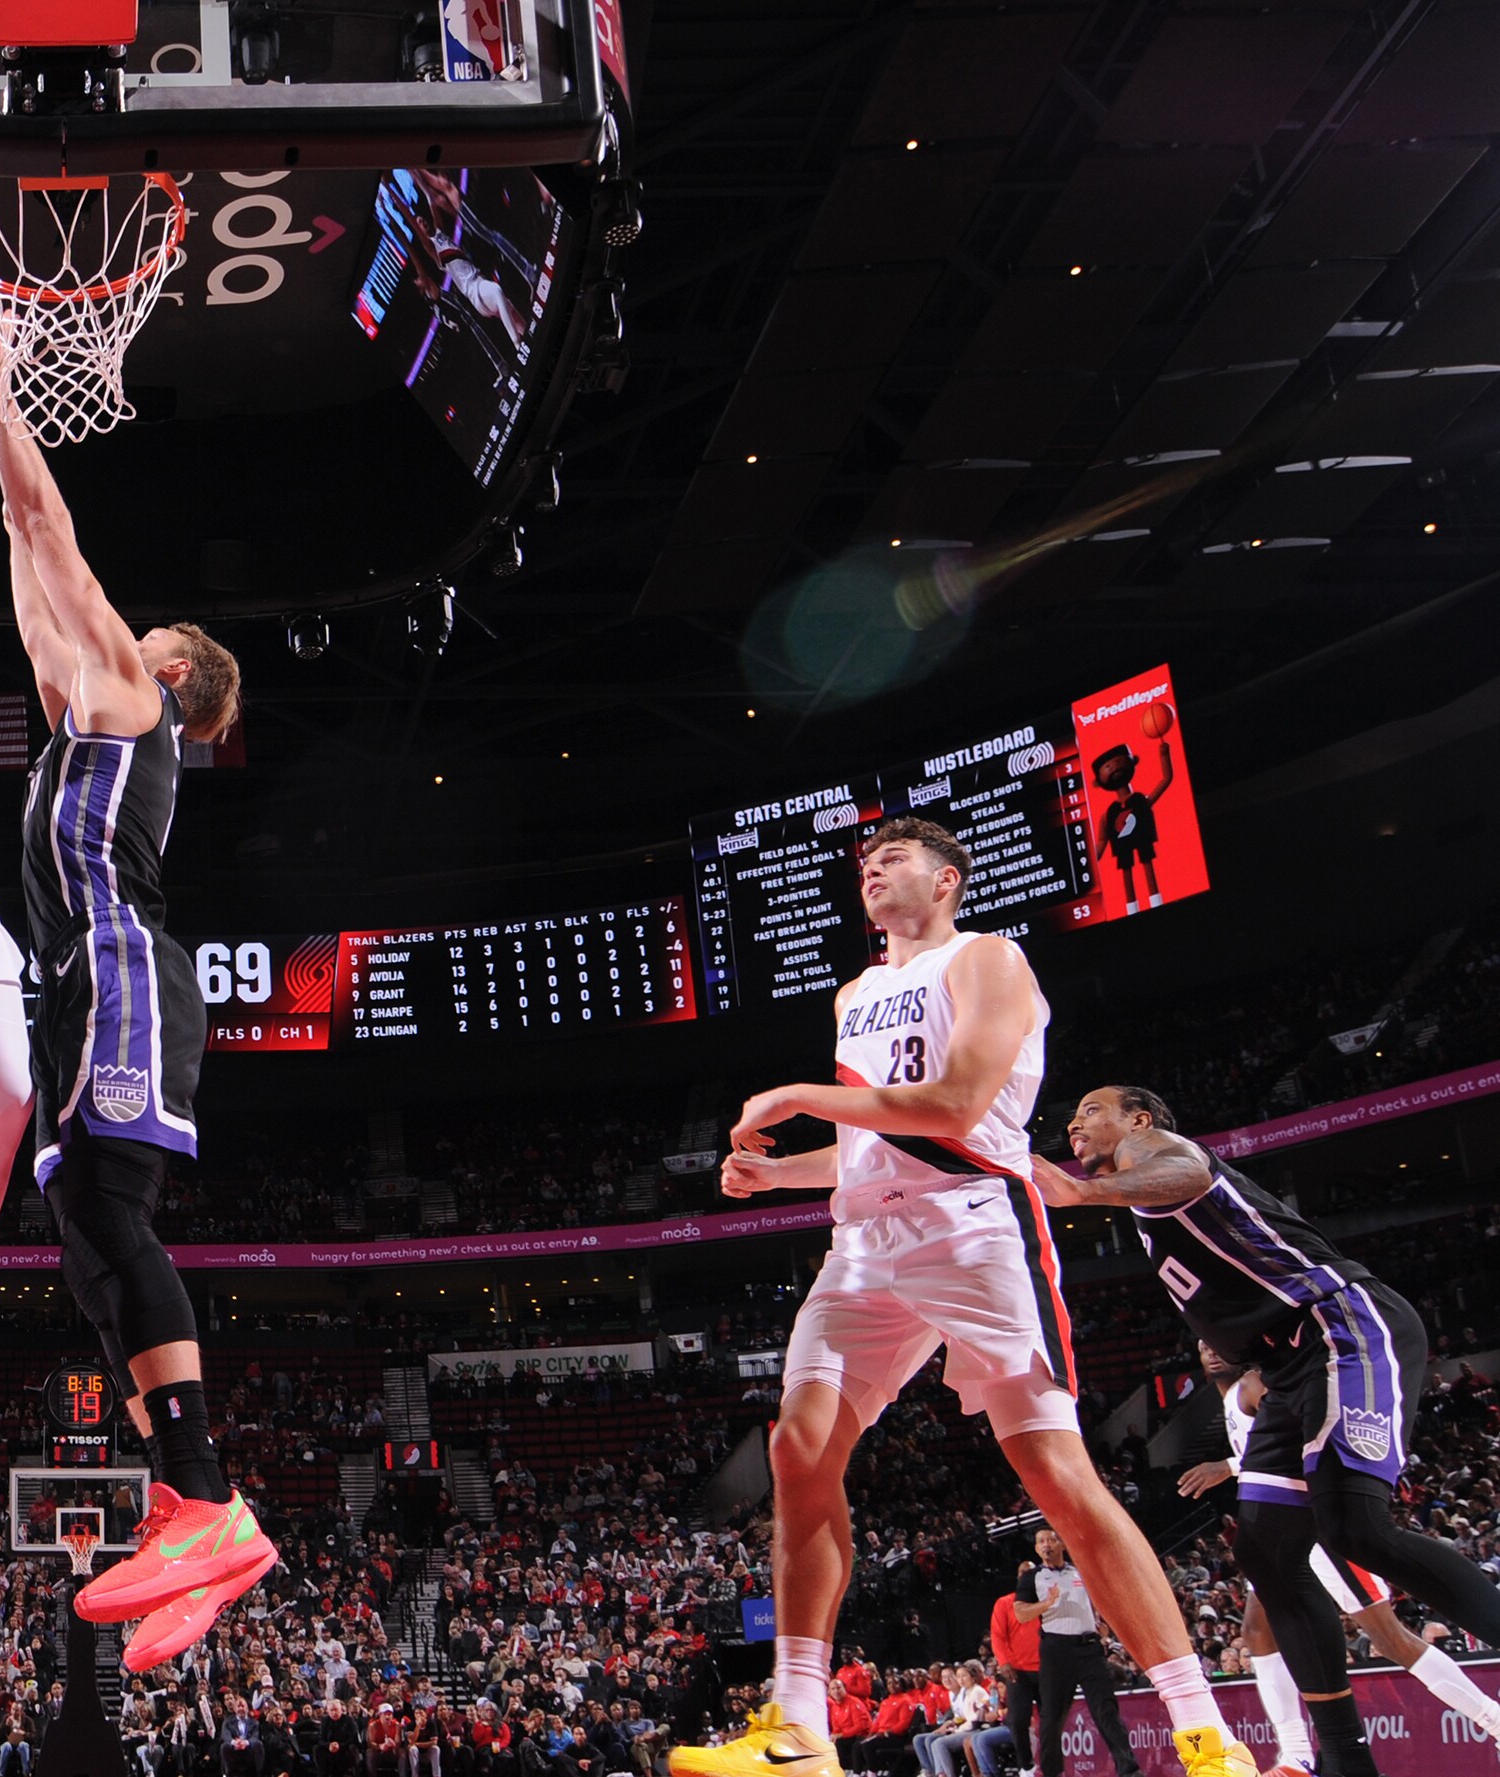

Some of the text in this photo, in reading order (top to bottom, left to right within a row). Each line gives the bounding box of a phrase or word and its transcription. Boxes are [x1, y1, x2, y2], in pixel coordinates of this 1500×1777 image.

[453, 61, 484, 80] NBA
[923, 725, 1036, 778] HUSTLEBOARD
[734, 784, 853, 827] STATS CENTRAL
[950, 781, 1023, 812] BLOCKED SHOTS
[971, 802, 1005, 820] STEALS
[956, 812, 1025, 841] OFF REBOUNDS
[974, 825, 1032, 851] CHANCE PTS
[759, 842, 809, 861] FIELD GOAL
[1002, 841, 1032, 858] TAKEN
[736, 851, 836, 881] EFFECTIVE FIELD GOAL
[988, 854, 1043, 880] TURNOVERS
[702, 877, 722, 888] 48.1
[761, 868, 823, 890] FREE THROWS
[979, 866, 1054, 895] OFF TURNOVERS
[701, 890, 726, 903] 15-21
[767, 887, 821, 907] 3-POINTERS
[973, 891, 1027, 915] VIOLATIONS
[1029, 879, 1066, 899] FORCED
[702, 909, 726, 921] 5-23
[760, 902, 832, 926] POINTS PAINT
[1073, 904, 1091, 920] 53
[347, 906, 650, 947] TRAIL BLAZERS PTS REB AST STL BLK TO FLS
[754, 915, 842, 942] FAST BREAK POINTS
[775, 935, 823, 952] REBOUNDS
[368, 946, 463, 965] HOLIDAY 12
[783, 951, 820, 966] ASSISTS
[195, 942, 272, 1004] 69
[368, 965, 466, 983] AVDIJA 13
[774, 963, 832, 983] TOTAL FOULS
[369, 983, 468, 1001] GRANT 14
[771, 977, 838, 999] BENCH POINTS
[353, 1001, 468, 1020] 17 SHARPE 15
[839, 986, 927, 1041] BLAZERS
[216, 1026, 300, 1041] FLS 0 CH
[355, 1024, 418, 1038] 23 CLINGAN
[886, 1036, 926, 1086] 23
[95, 1086, 146, 1102] KINGS
[1262, 1081, 1474, 1144] something new? check us out at
[661, 1223, 700, 1240] moda
[761, 1218, 778, 1229] for
[12, 1254, 40, 1264] new?
[238, 1249, 276, 1263] moda
[311, 1236, 600, 1264] hungry for something new? check out entry A9.
[452, 1358, 500, 1377] Sprite
[546, 1356, 584, 1373] CITY
[588, 1354, 629, 1371] ROW
[67, 1375, 103, 1392] 8:16
[73, 1392, 100, 1422] 19
[67, 1435, 109, 1445] TISSOT
[1347, 1426, 1389, 1446] KINGS
[1363, 1714, 1410, 1747] you.
